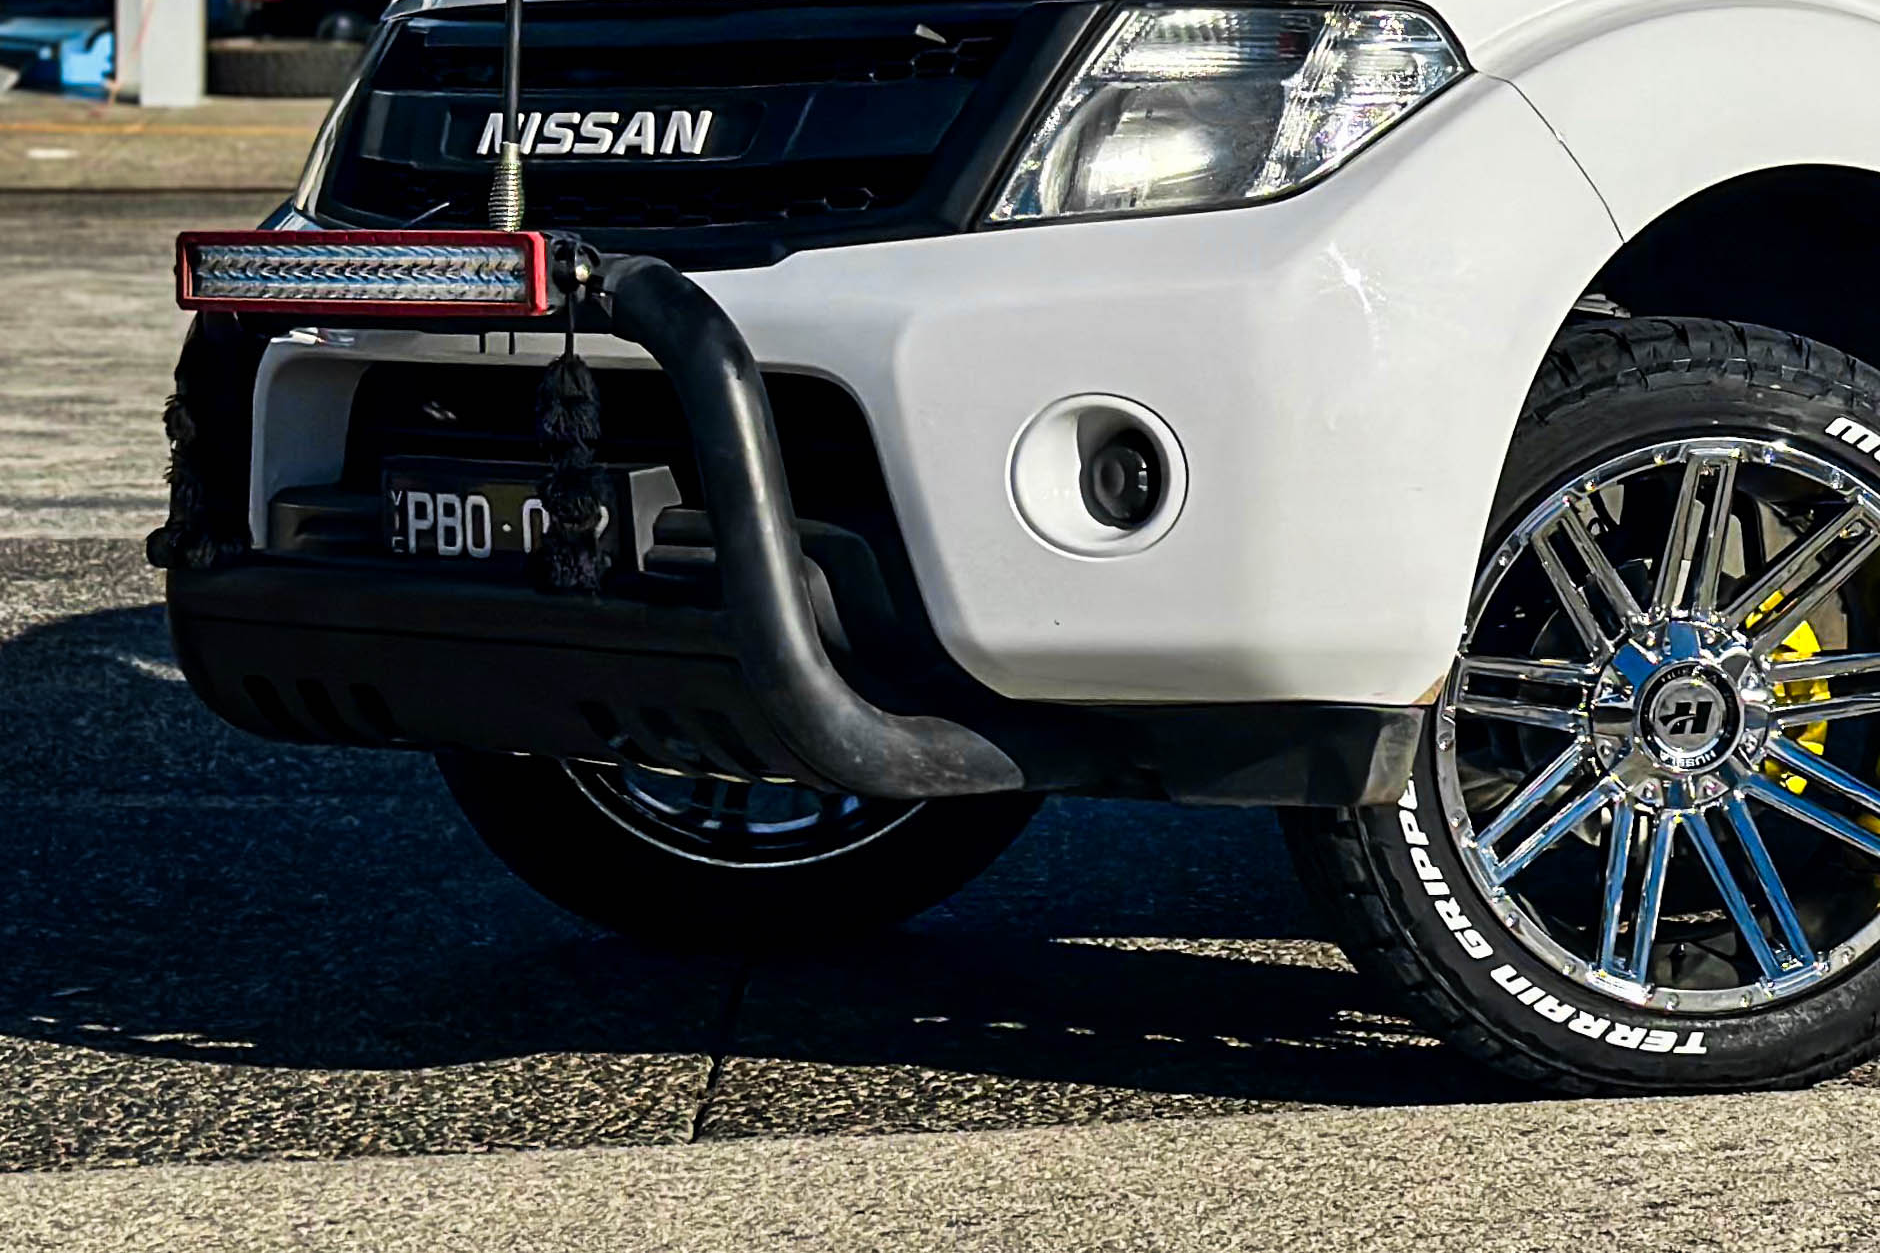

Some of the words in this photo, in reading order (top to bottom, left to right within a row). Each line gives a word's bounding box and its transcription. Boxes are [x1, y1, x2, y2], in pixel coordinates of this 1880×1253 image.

[476, 109, 713, 155] NISSAN
[1397, 777, 1495, 960] GRIPPE
[1490, 963, 1708, 1055] TERRAIN
